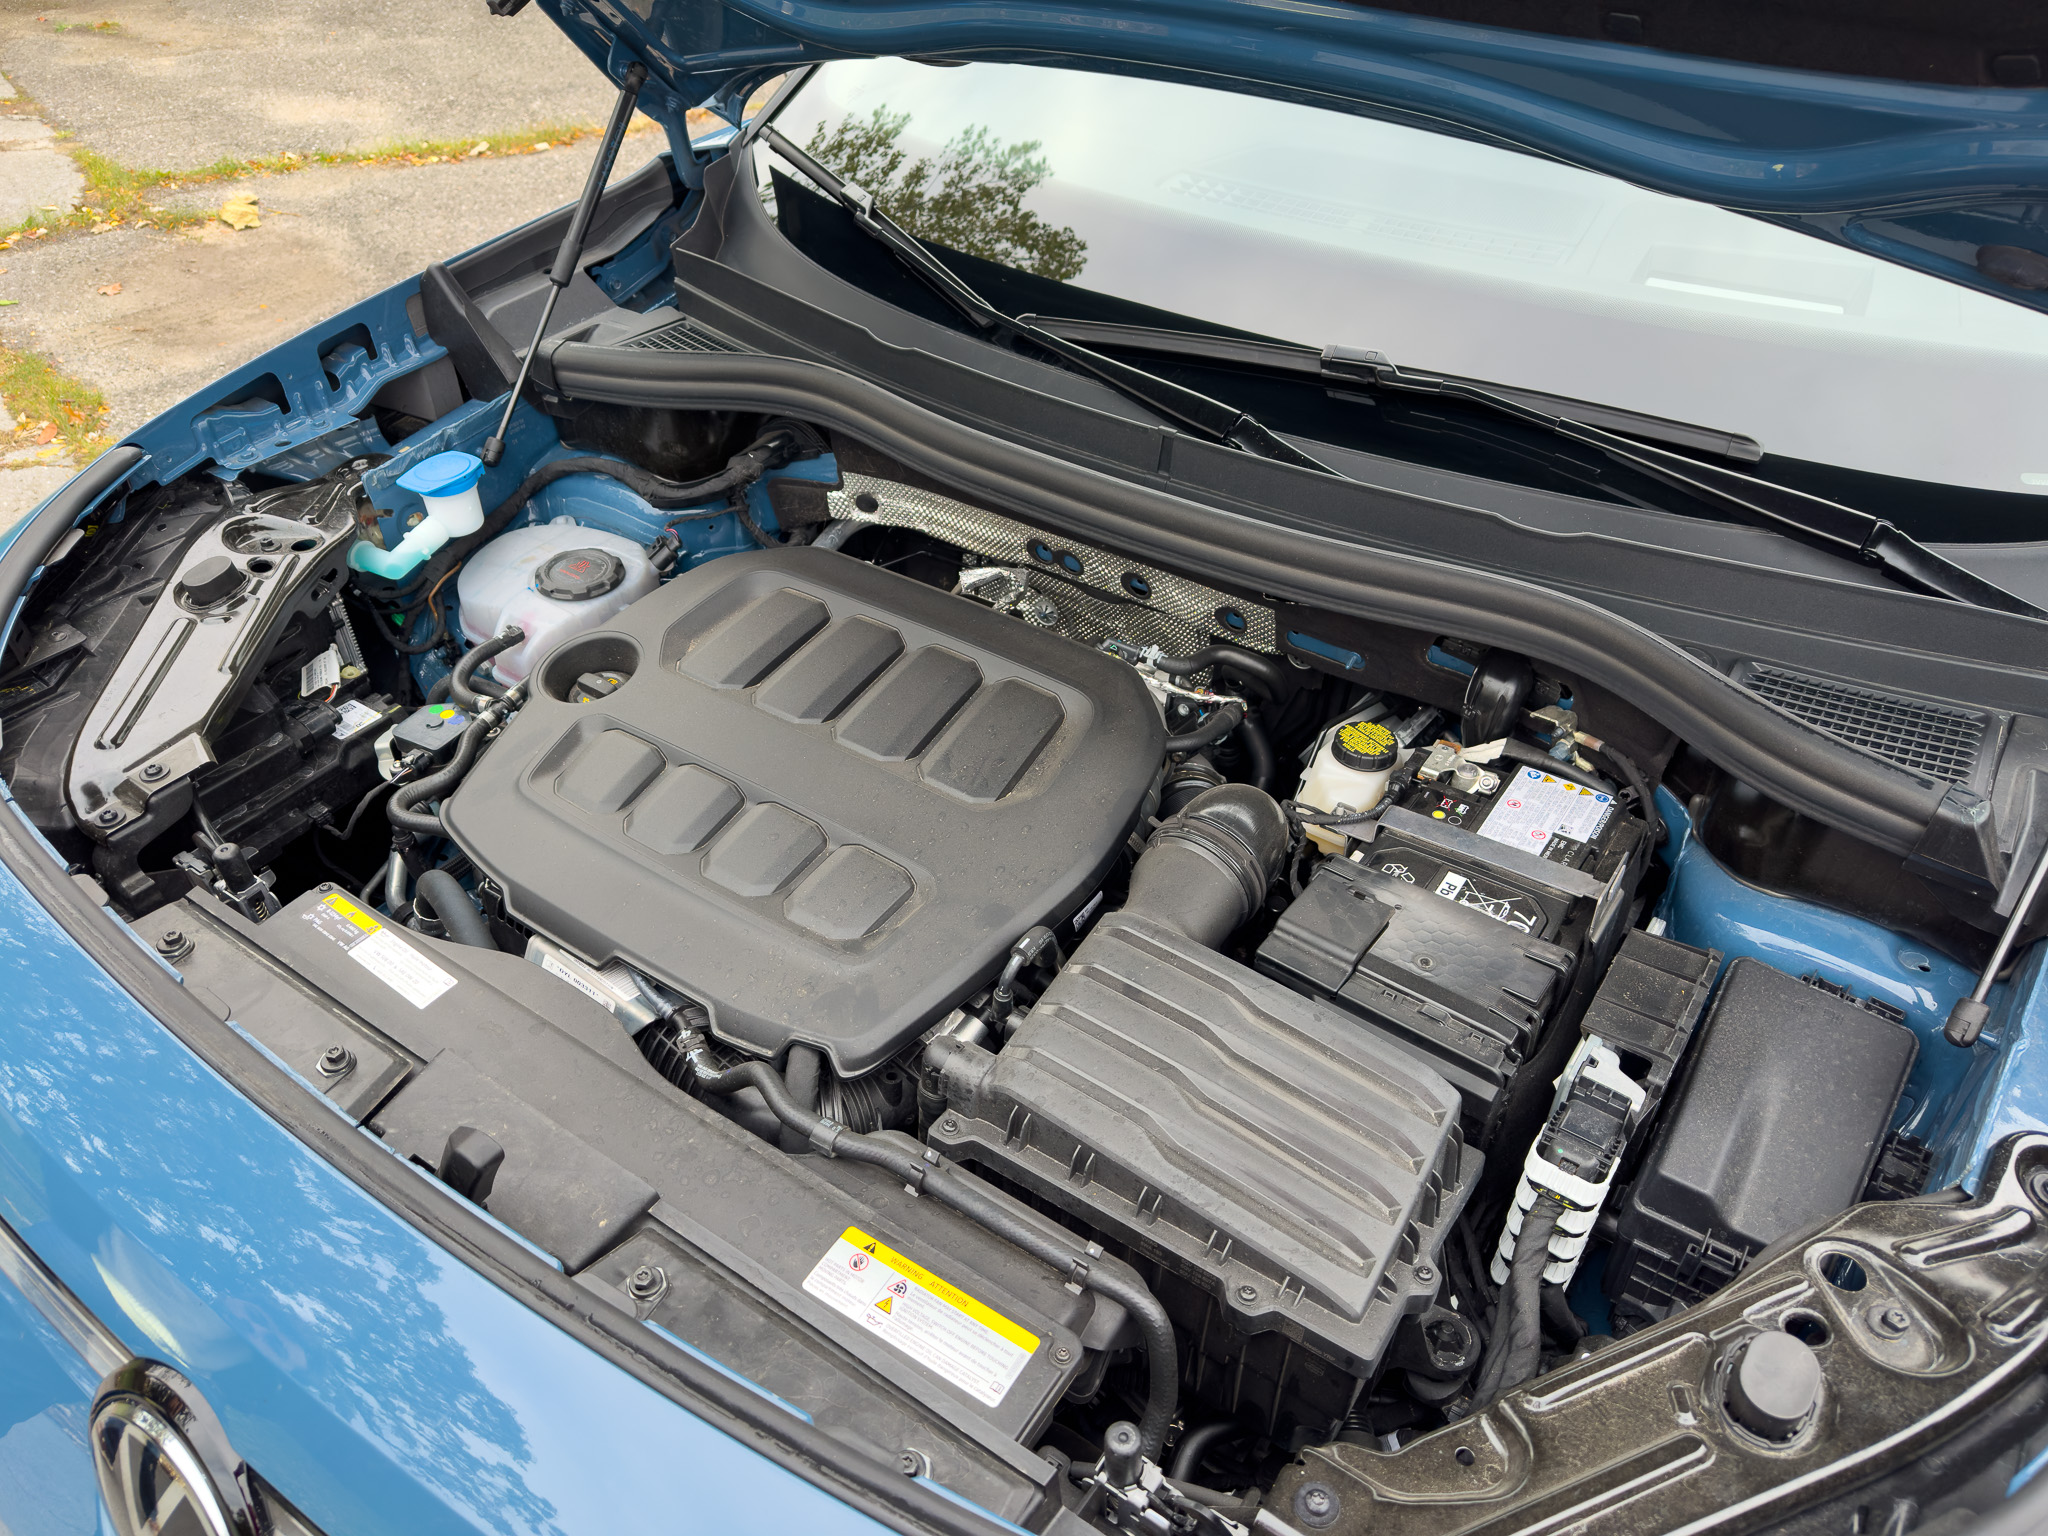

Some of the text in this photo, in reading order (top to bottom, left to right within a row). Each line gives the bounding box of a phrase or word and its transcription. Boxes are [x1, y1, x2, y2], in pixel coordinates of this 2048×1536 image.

[1441, 881, 1457, 896] Pb
[890, 1256, 969, 1308] WARNING ATTENTION
